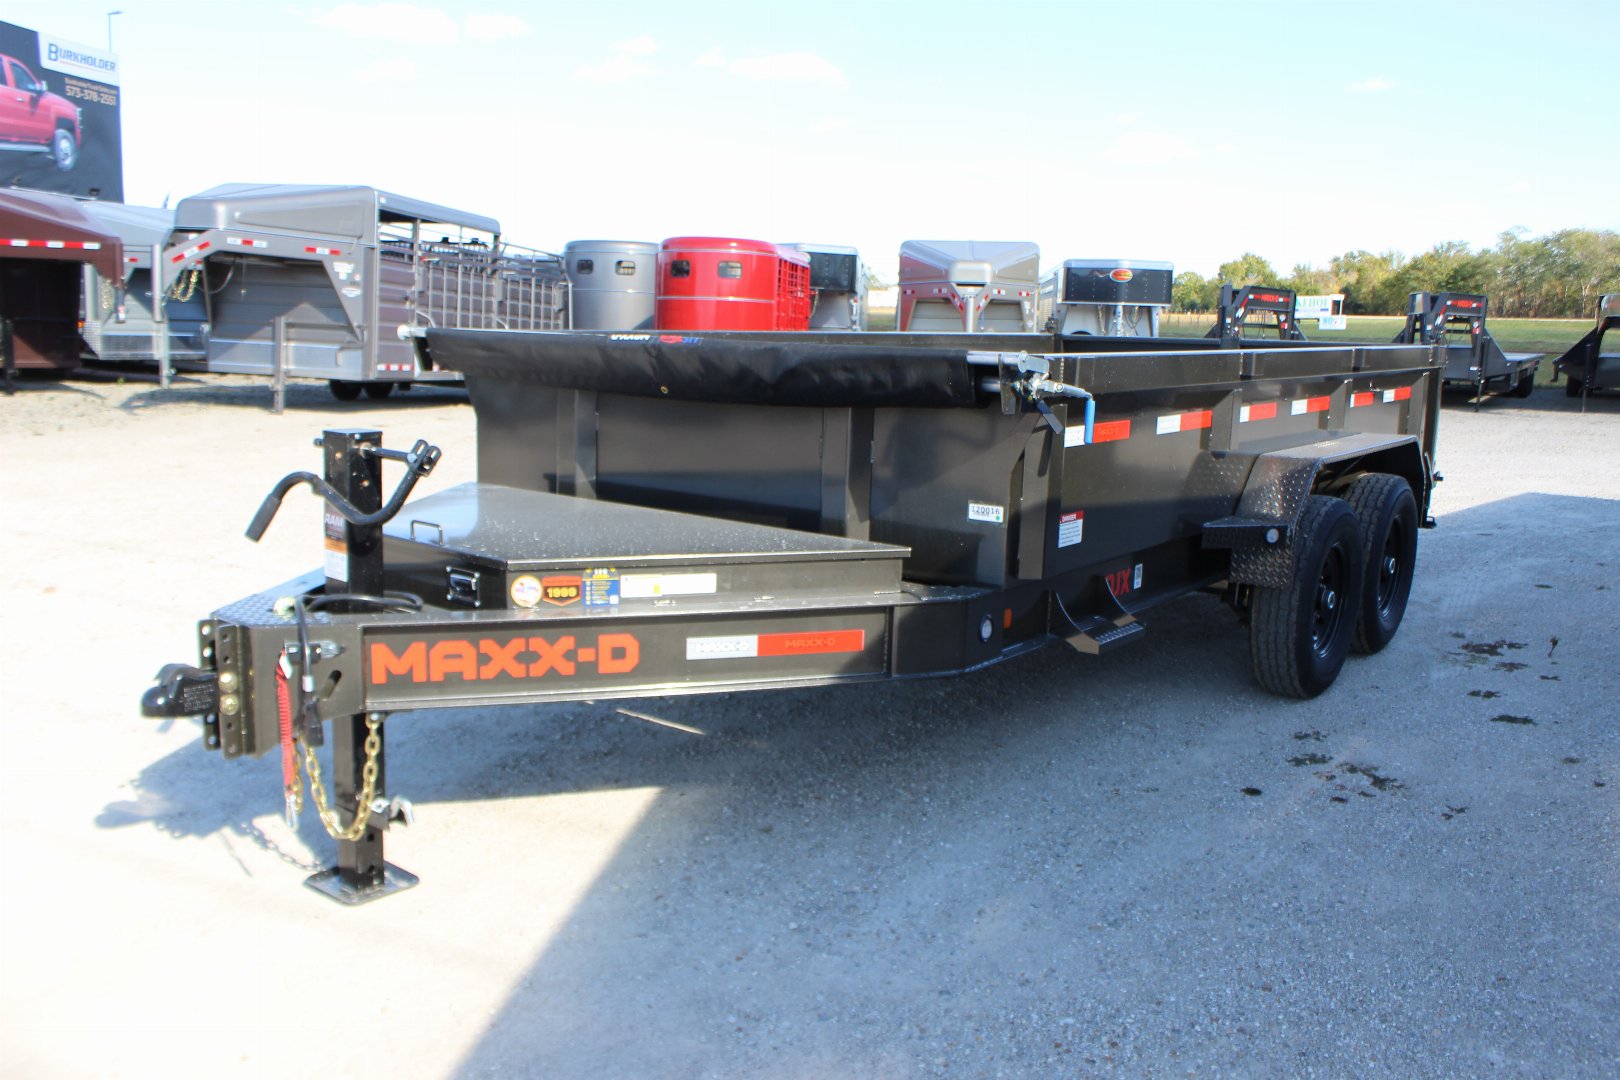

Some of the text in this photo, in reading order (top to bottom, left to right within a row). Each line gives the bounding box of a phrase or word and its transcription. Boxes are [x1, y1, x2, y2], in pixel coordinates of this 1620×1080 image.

[971, 505, 1001, 515] 120016
[784, 637, 836, 649] MAXX-D
[370, 633, 640, 684] MAXX-D
